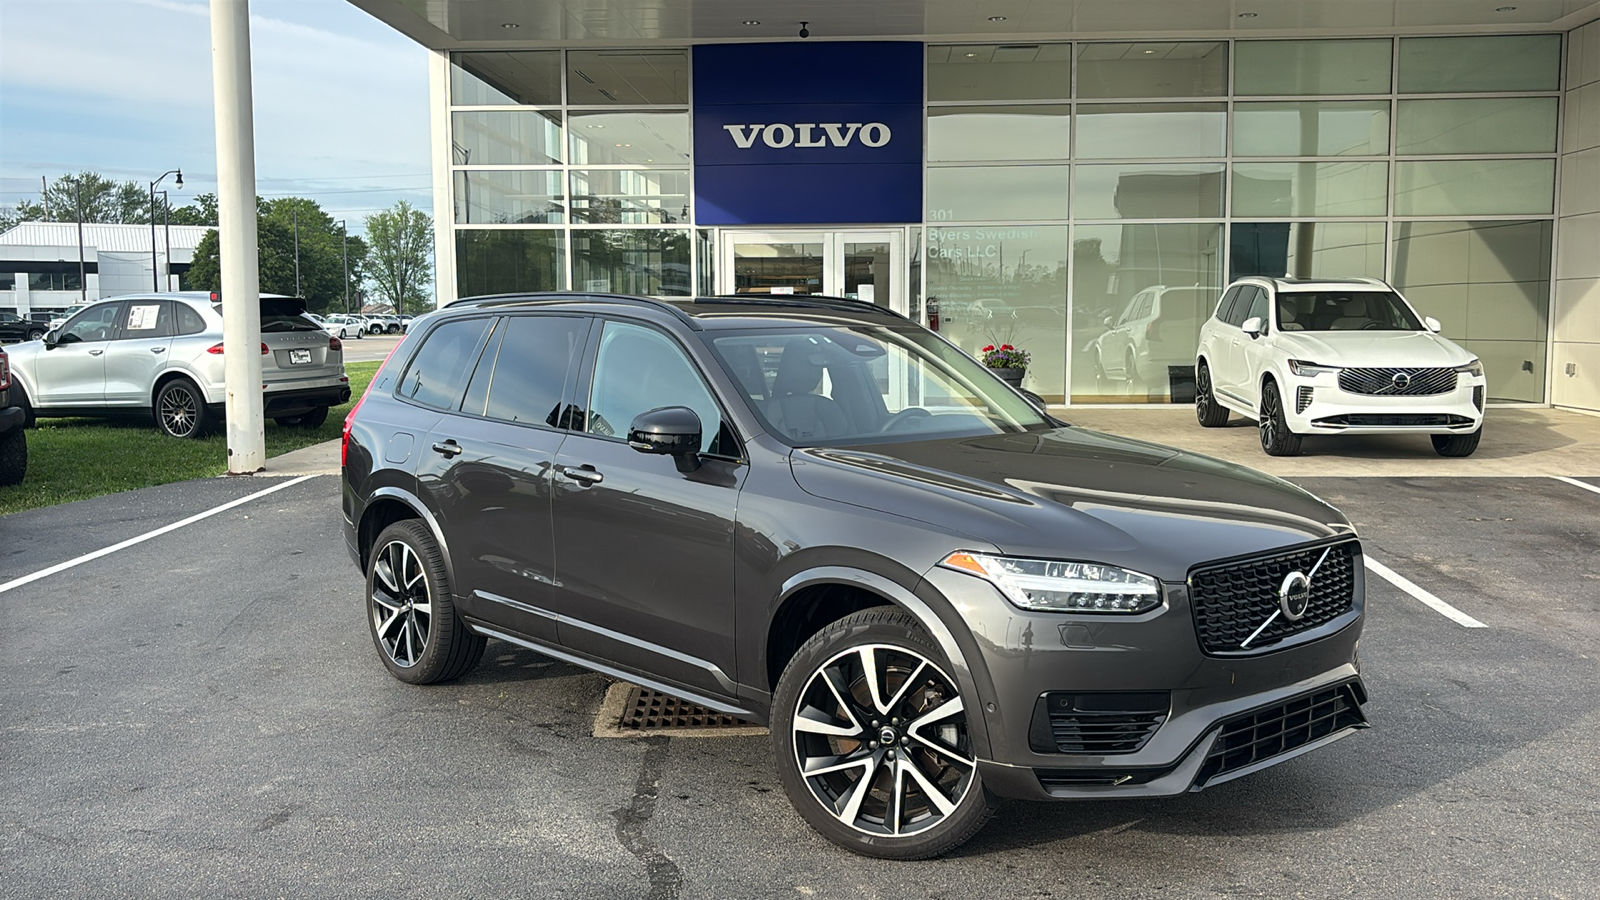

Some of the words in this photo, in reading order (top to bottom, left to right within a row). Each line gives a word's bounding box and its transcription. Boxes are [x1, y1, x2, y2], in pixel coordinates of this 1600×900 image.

[723, 123, 891, 148] VOLVO
[929, 209, 953, 220] 301
[928, 228, 970, 243] Byers
[975, 228, 1038, 240] Swedish
[928, 245, 962, 259] Cars
[967, 244, 997, 258] LLC
